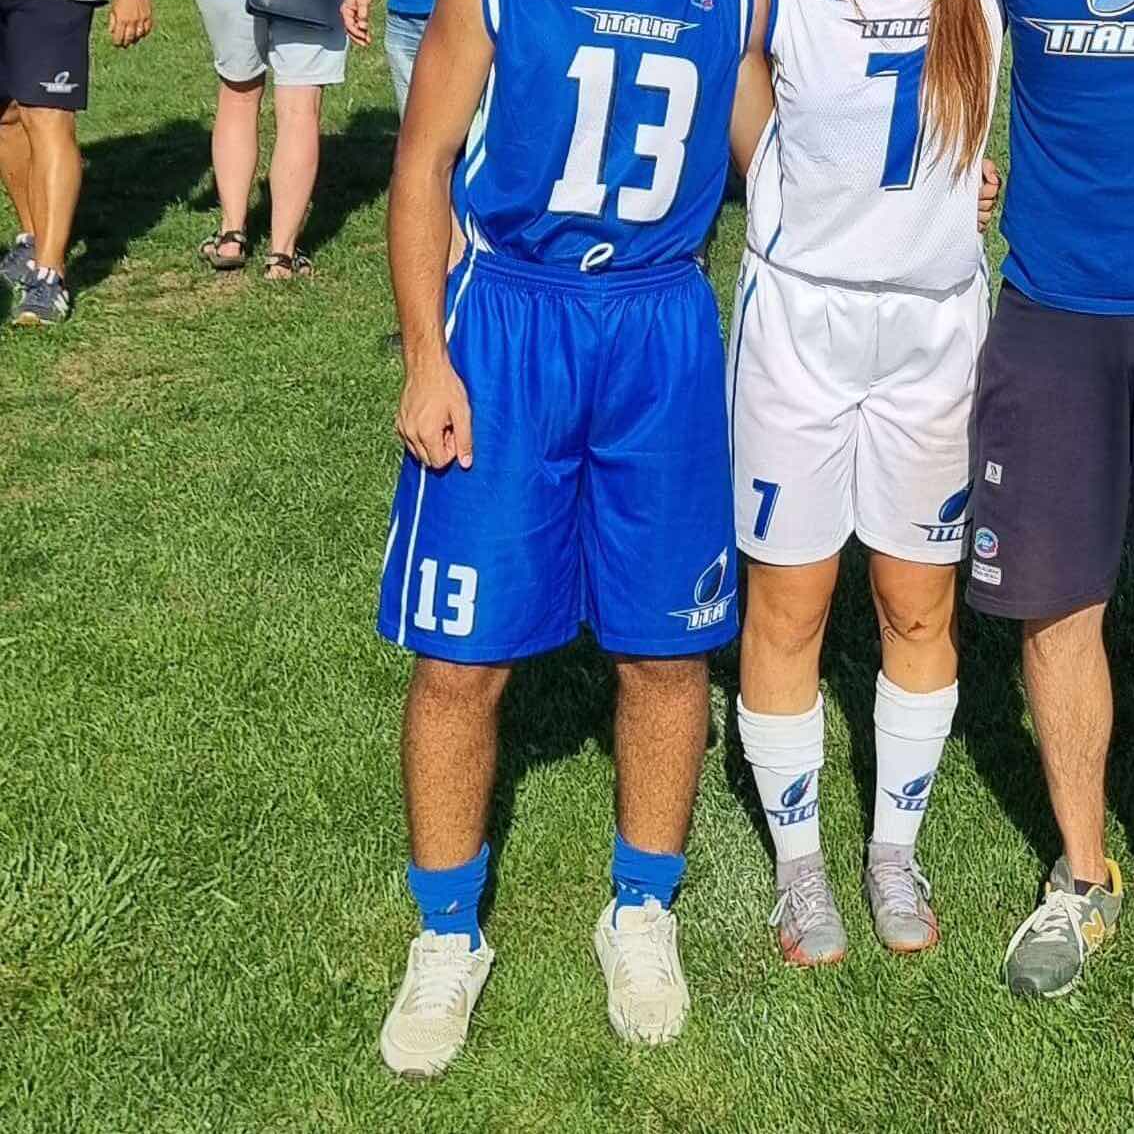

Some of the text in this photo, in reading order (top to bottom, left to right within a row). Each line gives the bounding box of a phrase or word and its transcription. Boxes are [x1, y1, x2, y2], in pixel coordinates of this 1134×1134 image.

[595, 12, 681, 40] ITALIA
[548, 46, 700, 223] 13
[866, 47, 927, 191] 7
[752, 478, 782, 541] 7
[414, 558, 478, 637] 13
[688, 600, 727, 627] ITA
